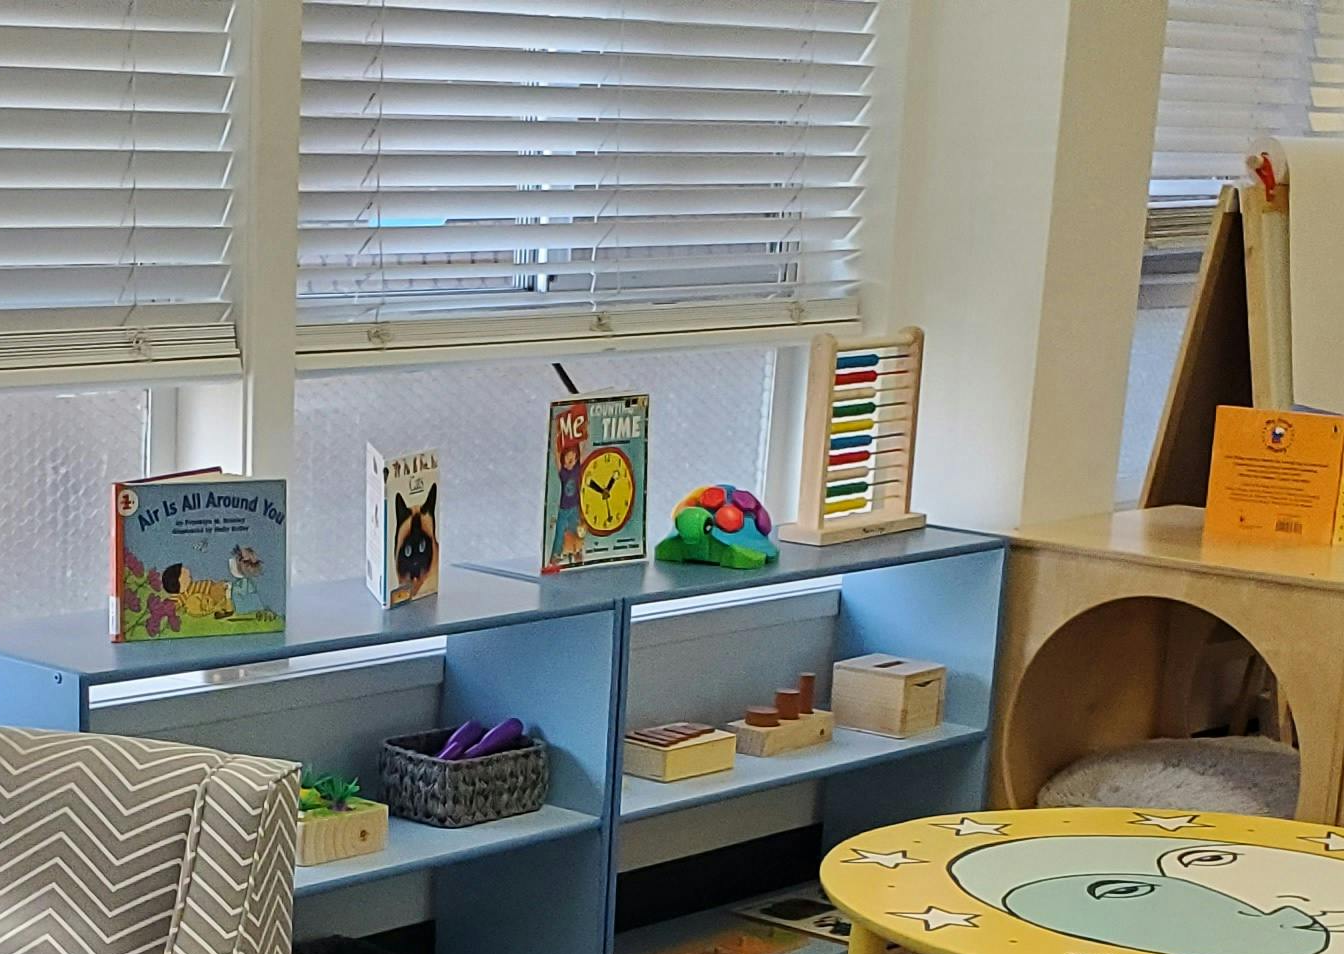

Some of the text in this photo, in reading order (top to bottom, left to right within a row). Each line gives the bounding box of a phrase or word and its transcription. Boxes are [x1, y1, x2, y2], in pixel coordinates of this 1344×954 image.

[559, 413, 585, 443] Me
[602, 415, 642, 441] TIME
[137, 507, 160, 532] Air
[162, 500, 178, 517] Is
[182, 492, 201, 512] All
[205, 491, 259, 513] Around
[263, 499, 286, 526] You
